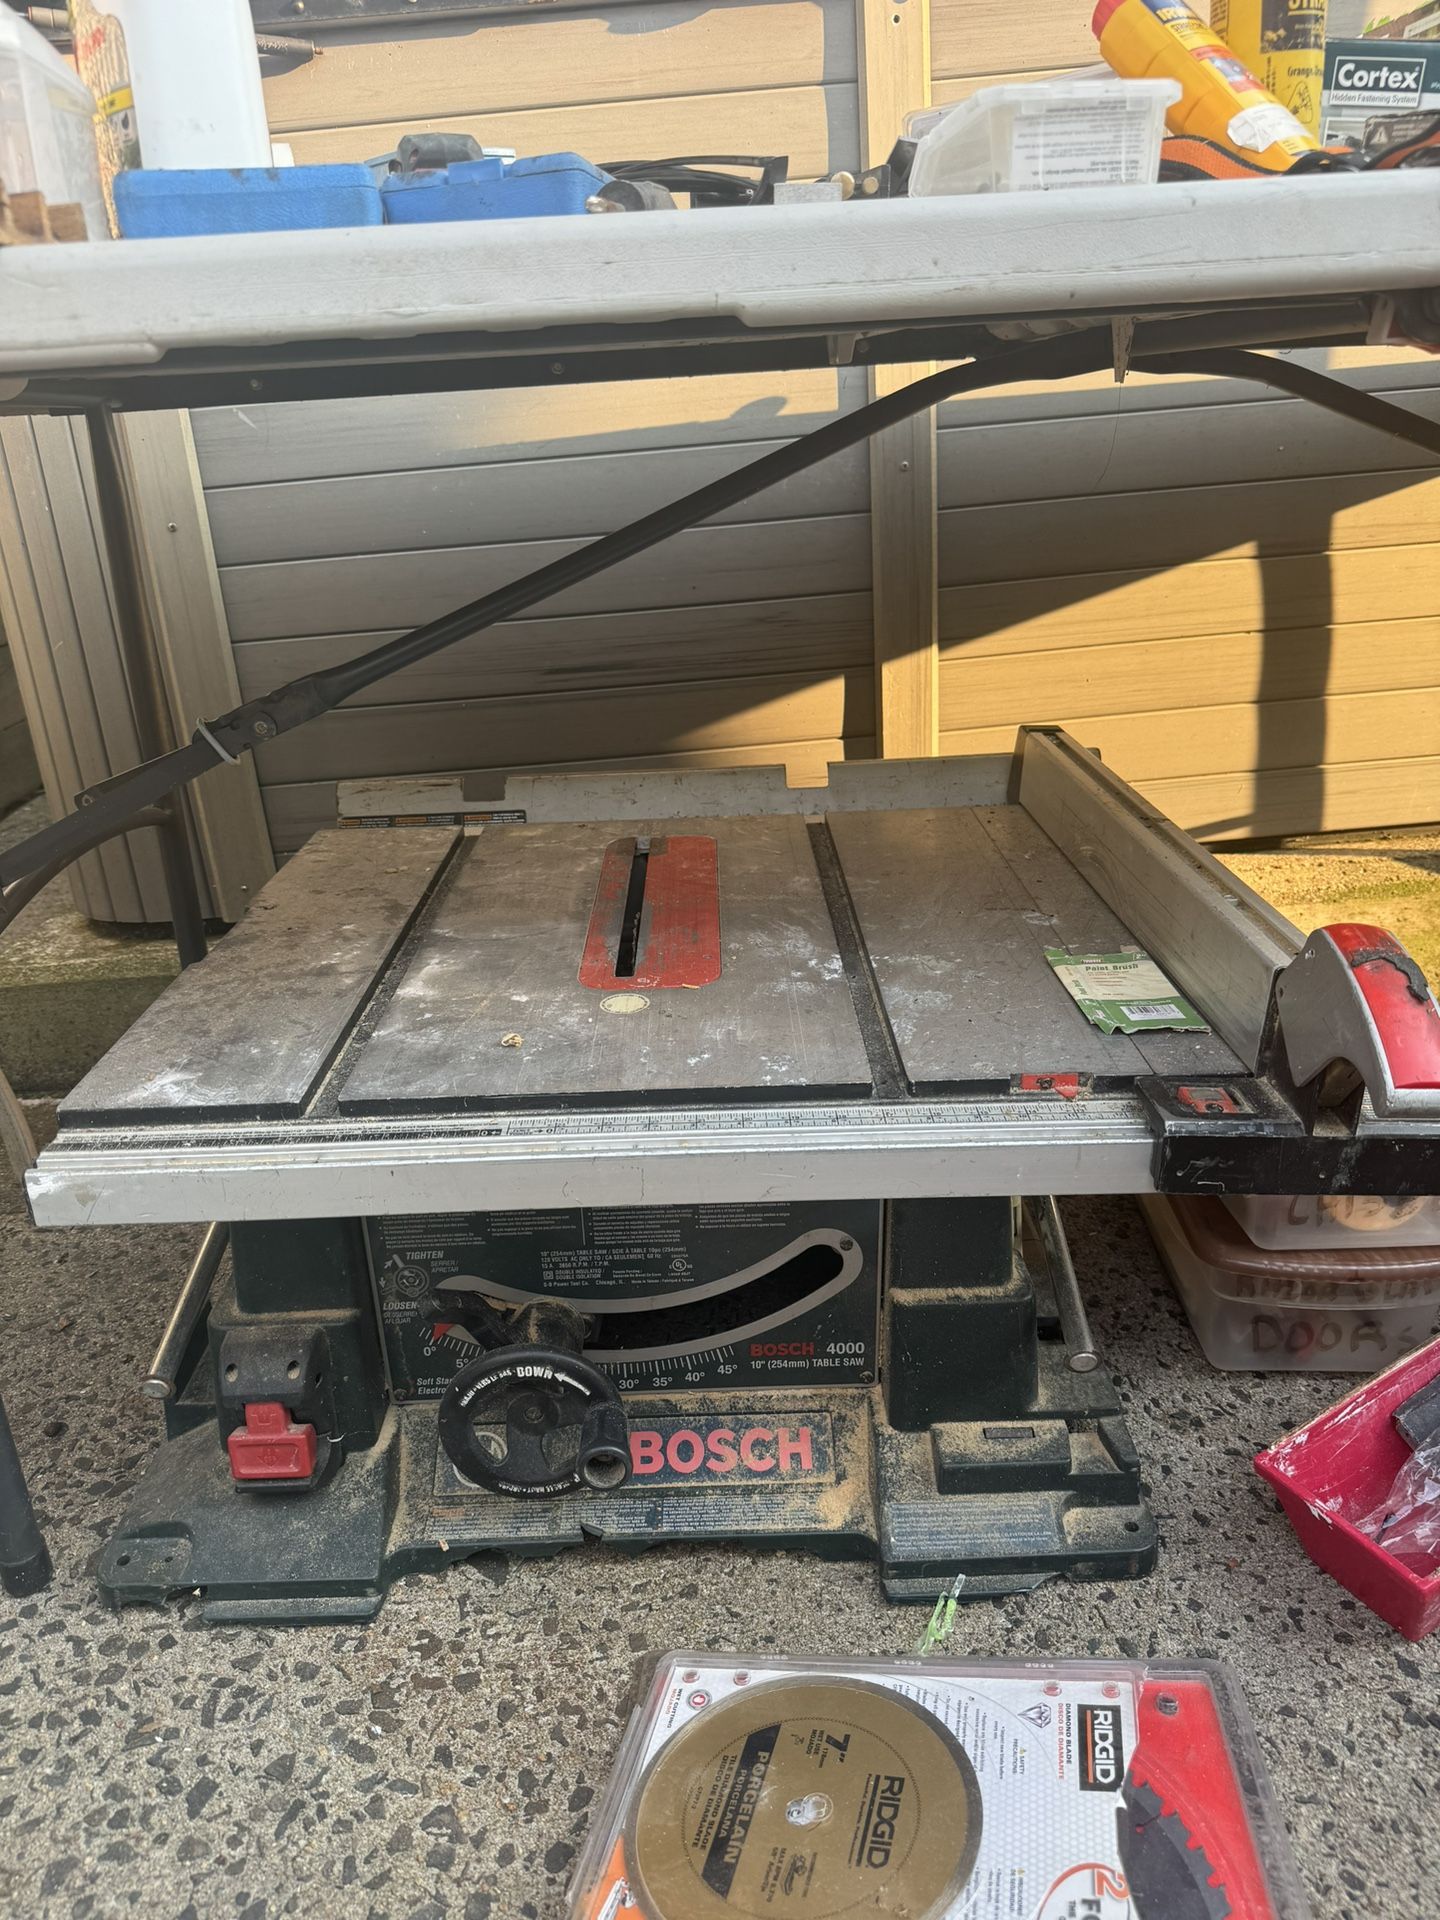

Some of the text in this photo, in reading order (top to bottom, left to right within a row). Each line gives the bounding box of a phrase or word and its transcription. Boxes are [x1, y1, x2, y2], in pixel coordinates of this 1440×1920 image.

[1338, 63, 1419, 89] Cortex
[1331, 93, 1417, 104] Hidden Fastening System
[1112, 963, 1139, 971] Brush
[406, 1250, 444, 1260] TIGHTEN
[383, 1301, 417, 1310] LOOSEN
[751, 1342, 865, 1357] BOSCH 4000
[717, 1364, 738, 1375] 45°
[751, 1357, 865, 1369] 10" (254mm) TABLE SAW
[517, 1366, 553, 1380] DOWN
[685, 1371, 706, 1382] 40°
[417, 1378, 435, 1386] Soft
[619, 1379, 640, 1389] 30°
[652, 1376, 673, 1387] 35°
[629, 1426, 813, 1474] BOSCH
[666, 1702, 679, 1728] CUTTING
[1058, 1726, 1064, 1736] DE
[806, 1729, 817, 1755] MOJADO
[1094, 1710, 1116, 1784] RIDGID
[714, 1755, 728, 1782] DISCO
[709, 1783, 718, 1795] DE
[700, 1755, 737, 1850] TILE DIAMOND BLADE
[718, 1769, 747, 1838] PORCELANA
[723, 1751, 771, 1864] PORCELAIN
[692, 1795, 714, 1848] DIAMANTE
[866, 1775, 905, 1869] RIDGID
[1094, 1868, 1130, 1899] 2
